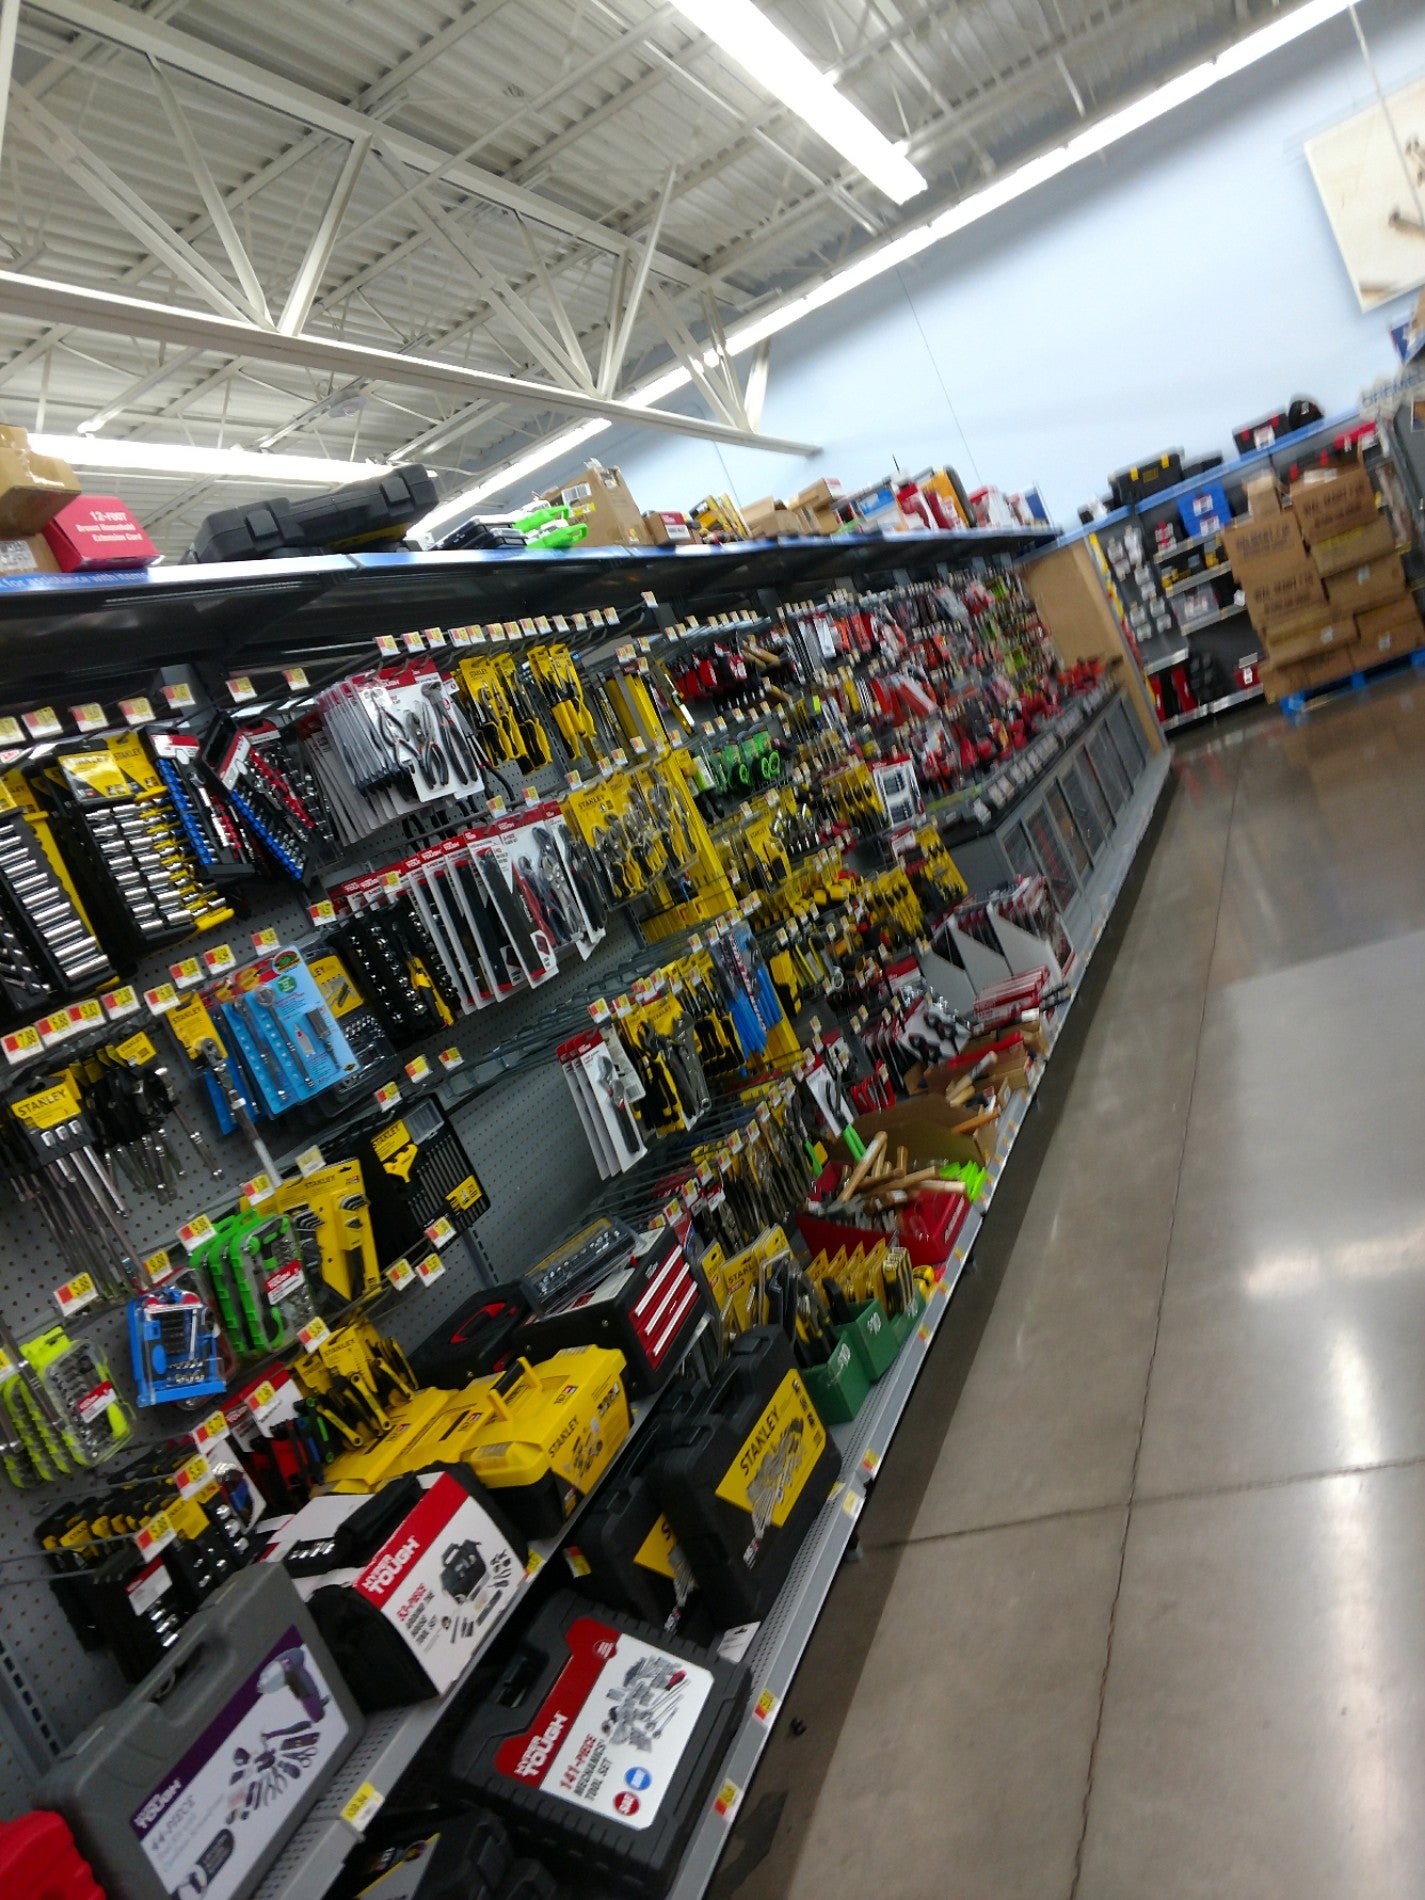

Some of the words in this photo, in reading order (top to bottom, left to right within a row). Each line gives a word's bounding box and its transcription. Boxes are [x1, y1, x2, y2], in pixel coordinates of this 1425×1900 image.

[114, 747, 142, 760] STANLEY
[577, 795, 606, 809] STANLEY
[172, 1006, 202, 1025] STANLEY
[120, 1035, 144, 1053] STANLEY
[18, 1088, 68, 1116] STANLEY
[371, 1122, 402, 1149] STANLEY
[304, 1174, 336, 1189] STANLEY
[323, 1339, 357, 1356] STANLEY
[548, 1414, 579, 1458] STANLEY
[740, 1405, 779, 1476] STANLEY
[362, 1553, 395, 1590] HYPER
[368, 1536, 421, 1594] TOUGH
[514, 1735, 541, 1776] HYPER
[522, 1711, 569, 1777] TOUGH
[559, 1732, 598, 1791] 141-PIECE
[584, 1777, 604, 1802] TOOL
[599, 1757, 613, 1778] SET
